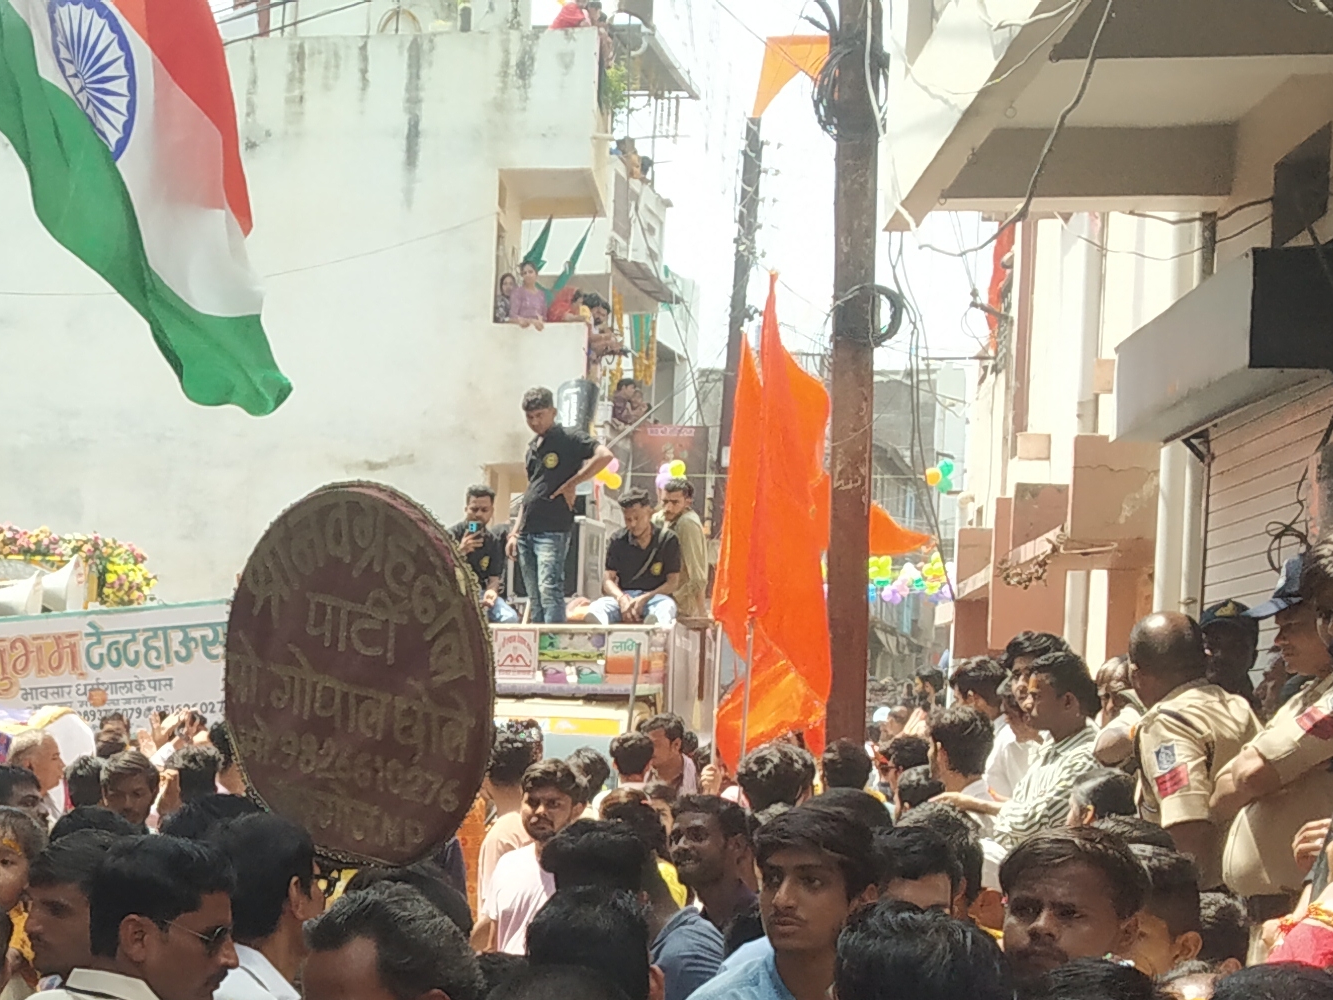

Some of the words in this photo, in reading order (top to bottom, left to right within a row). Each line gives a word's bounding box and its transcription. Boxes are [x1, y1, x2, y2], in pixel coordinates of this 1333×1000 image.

[19, 684, 73, 701] भावसार
[134, 675, 146, 693] के
[147, 677, 174, 692] पास
